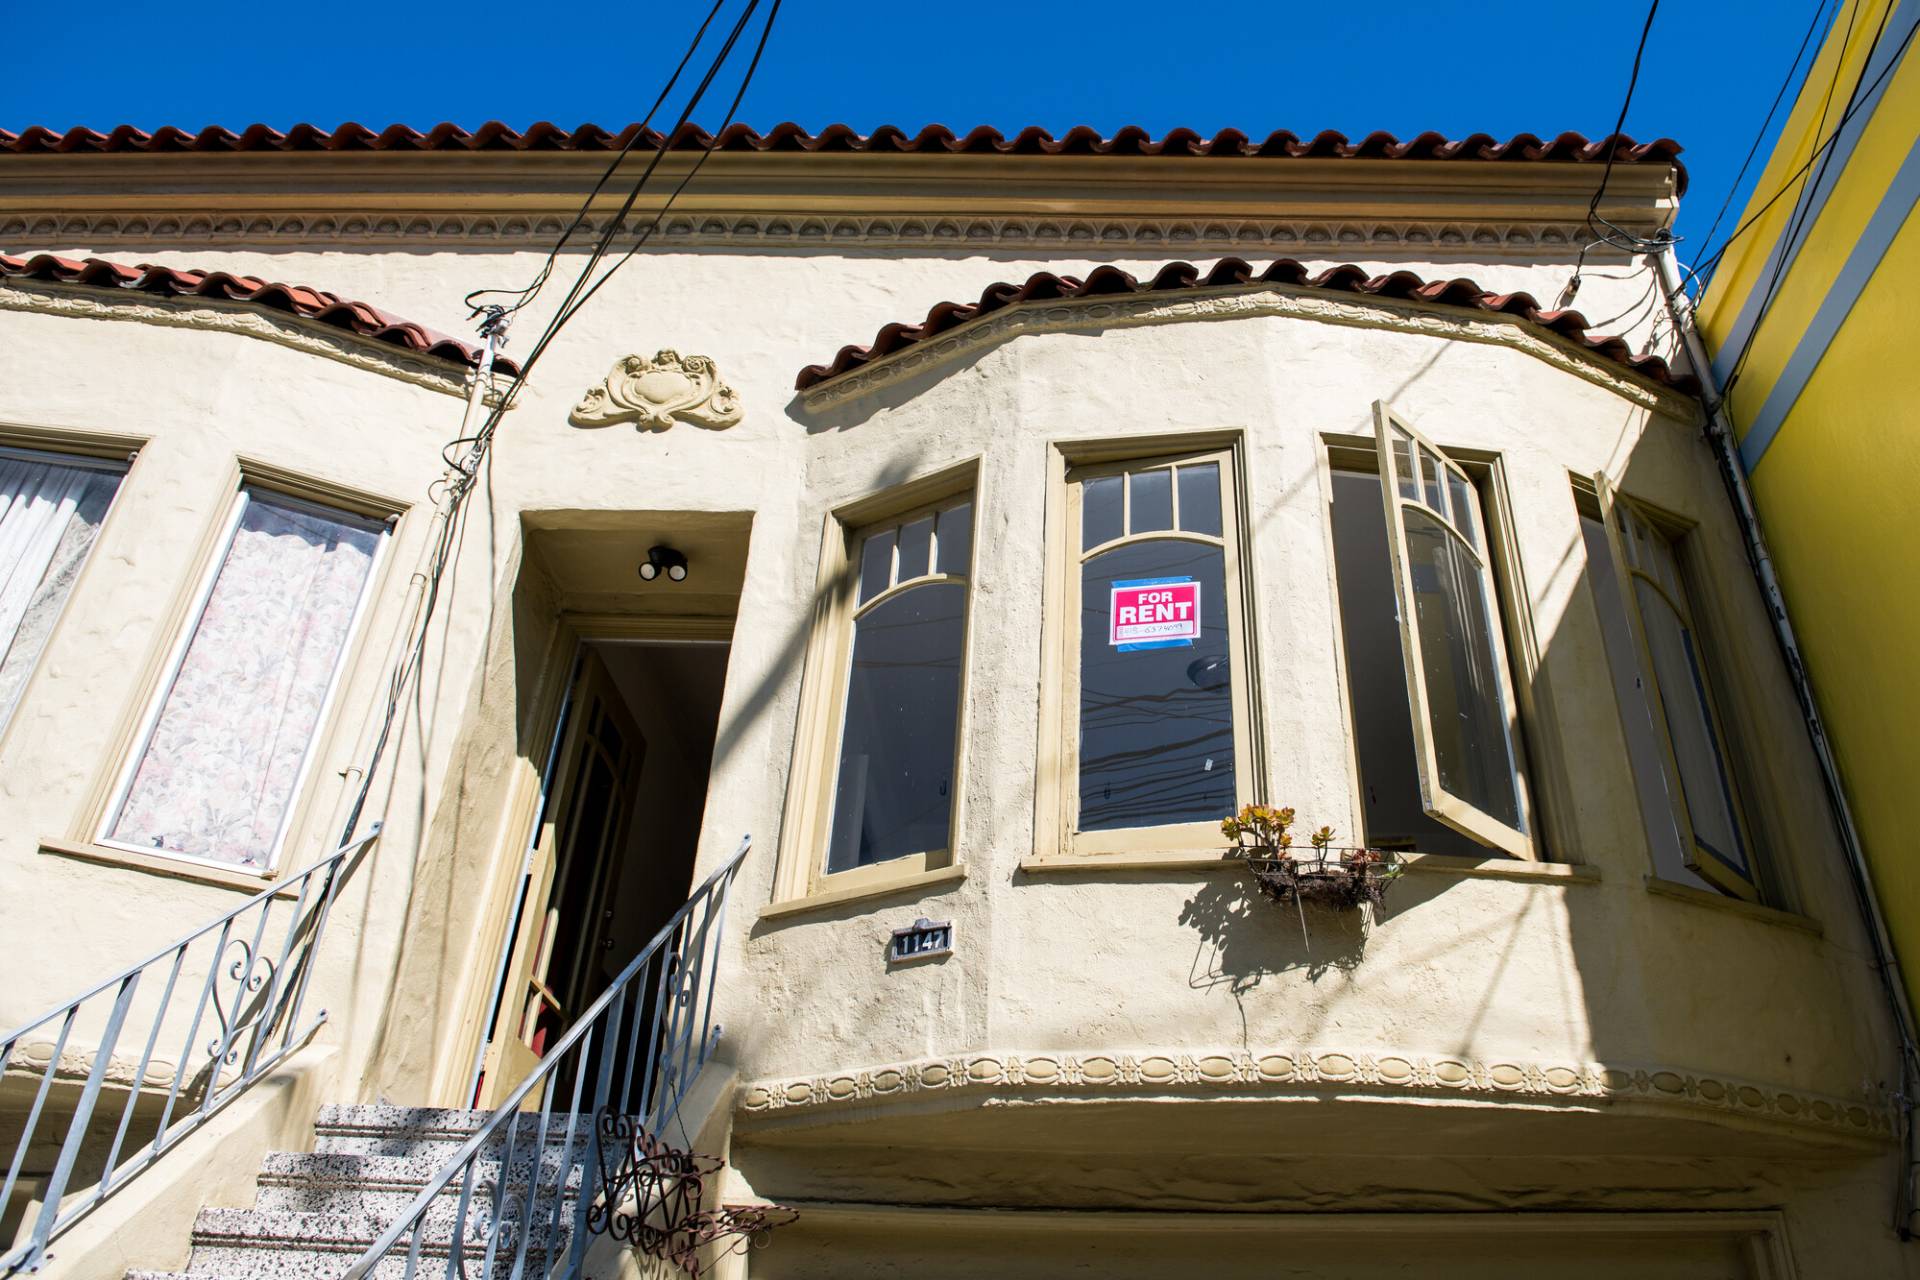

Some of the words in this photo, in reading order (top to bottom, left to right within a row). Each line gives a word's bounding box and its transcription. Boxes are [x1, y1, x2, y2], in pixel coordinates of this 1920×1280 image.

[1138, 592, 1173, 604] FOR
[1119, 602, 1192, 624] RENT
[903, 930, 943, 953] 1147
